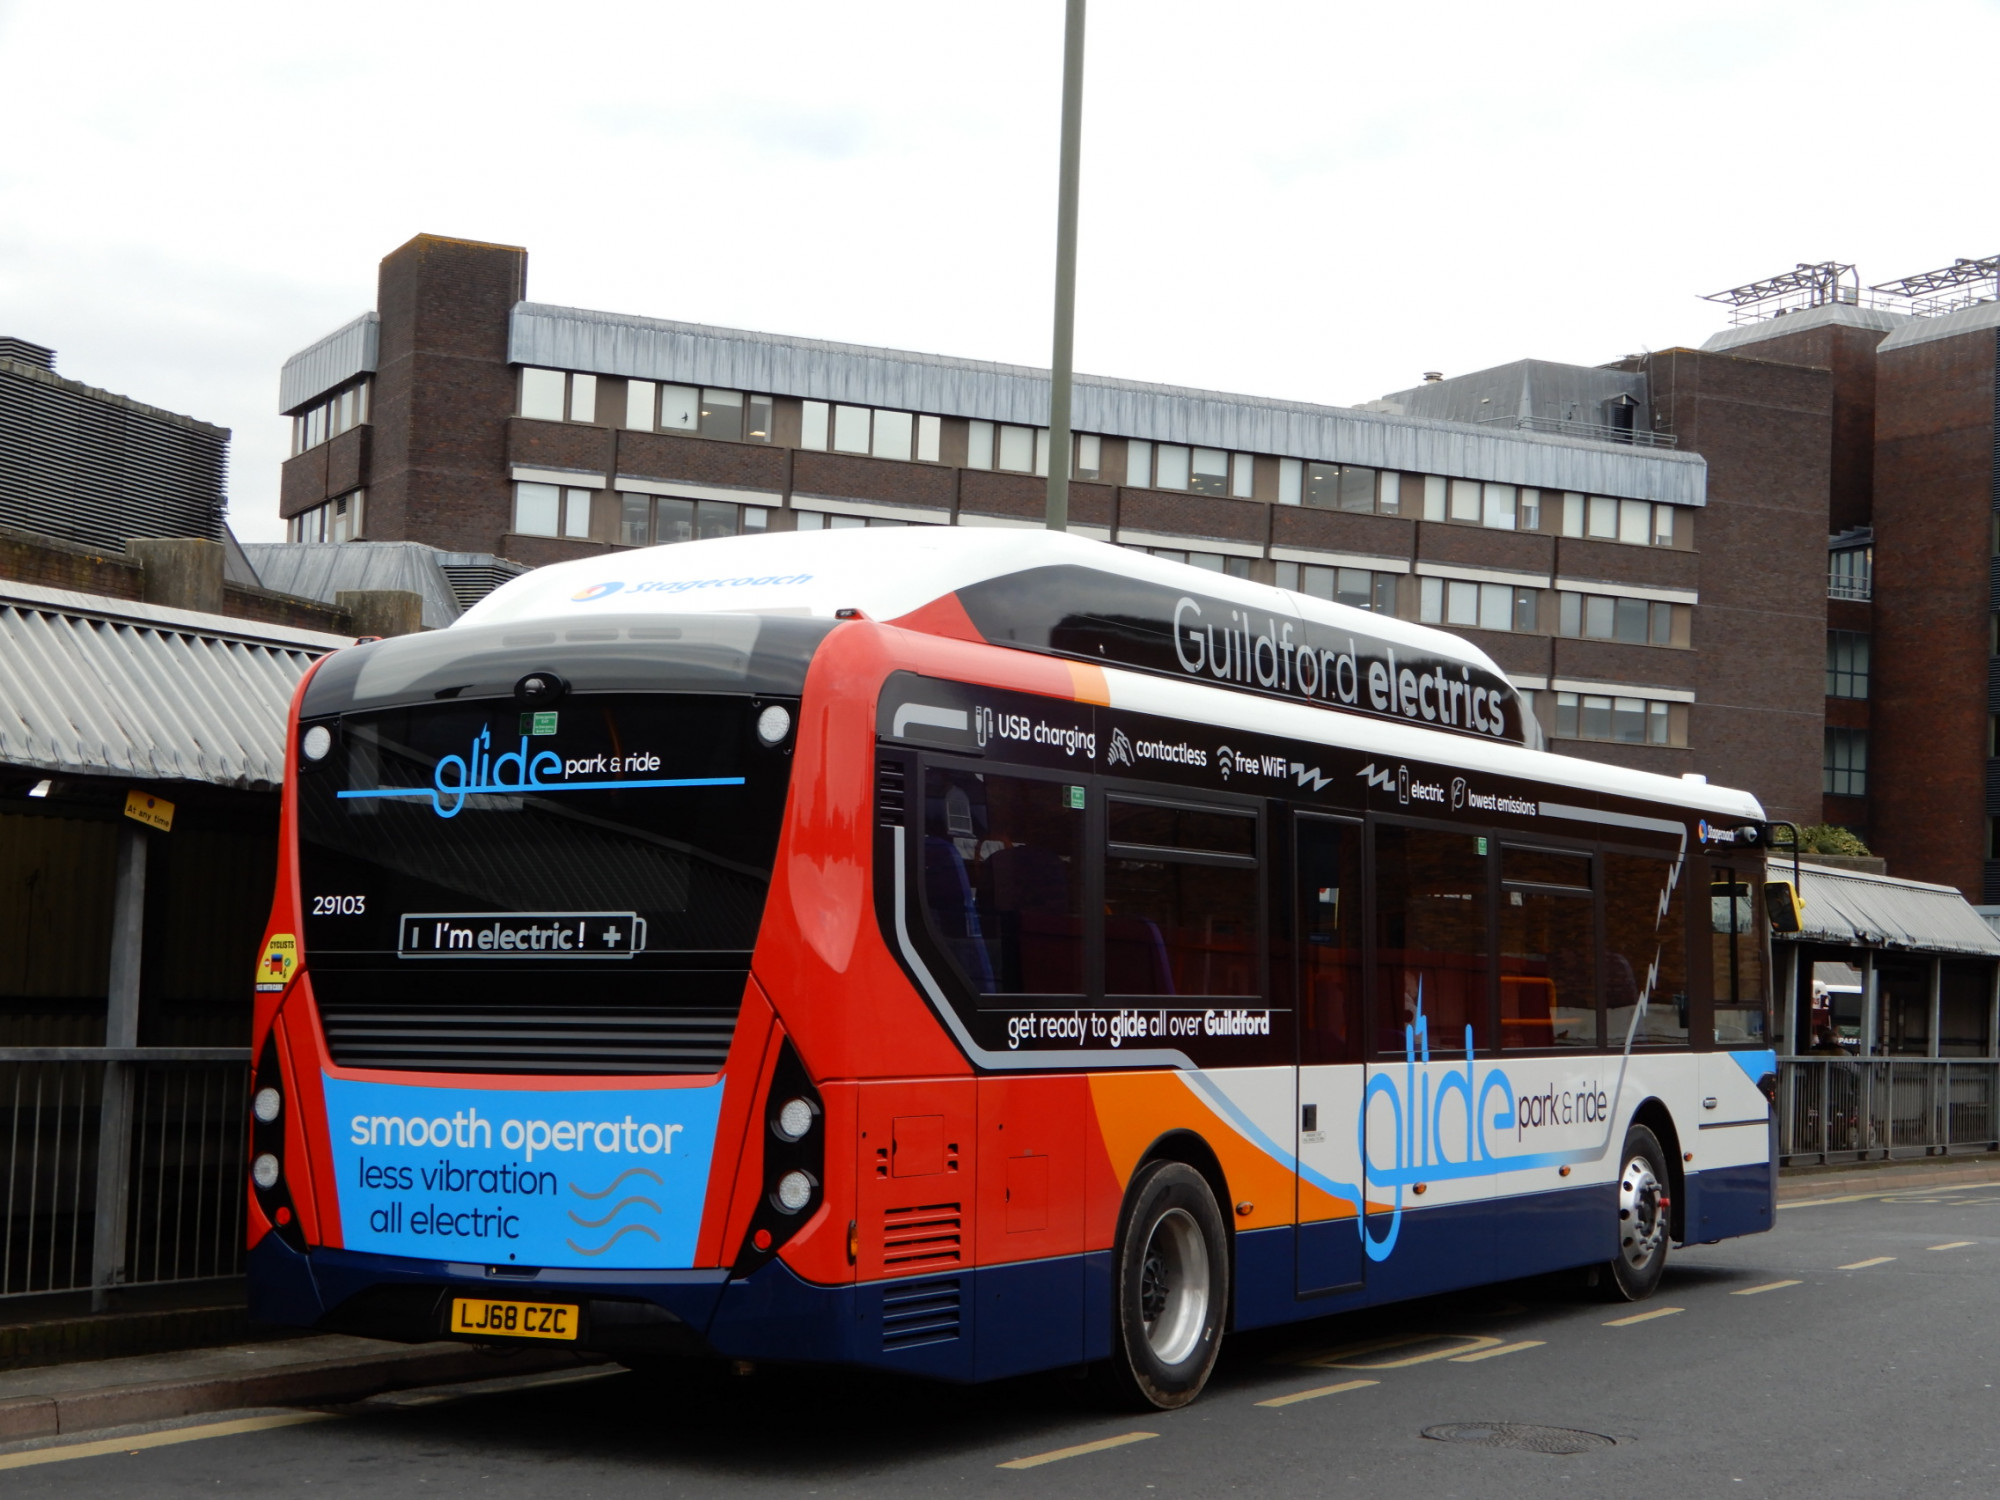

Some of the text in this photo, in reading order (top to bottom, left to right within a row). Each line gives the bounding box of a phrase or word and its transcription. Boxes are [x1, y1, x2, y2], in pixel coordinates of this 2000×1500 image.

[625, 573, 814, 594] Stagecoach
[1174, 597, 1505, 736] Guildford electrics
[998, 713, 1096, 759] USB charging
[1136, 740, 1207, 767] contactless
[1235, 751, 1287, 779] free WiFi
[434, 722, 661, 818] glide park & ride
[1411, 780, 1444, 803] electric
[1468, 789, 1536, 816] lowest emissions
[127, 804, 170, 827] At any time
[312, 895, 366, 915] 29103
[270, 940, 295, 949] CYCLISTS
[435, 922, 473, 949] I'm
[1008, 1009, 1271, 1049] get ready to glide all over Guildford
[1357, 971, 1607, 1262] glide park & ride
[350, 1107, 683, 1163] smooth operator
[358, 1156, 557, 1196] less vibration
[369, 1201, 520, 1239] all electric
[461, 1303, 567, 1333] LJ68 CZC
